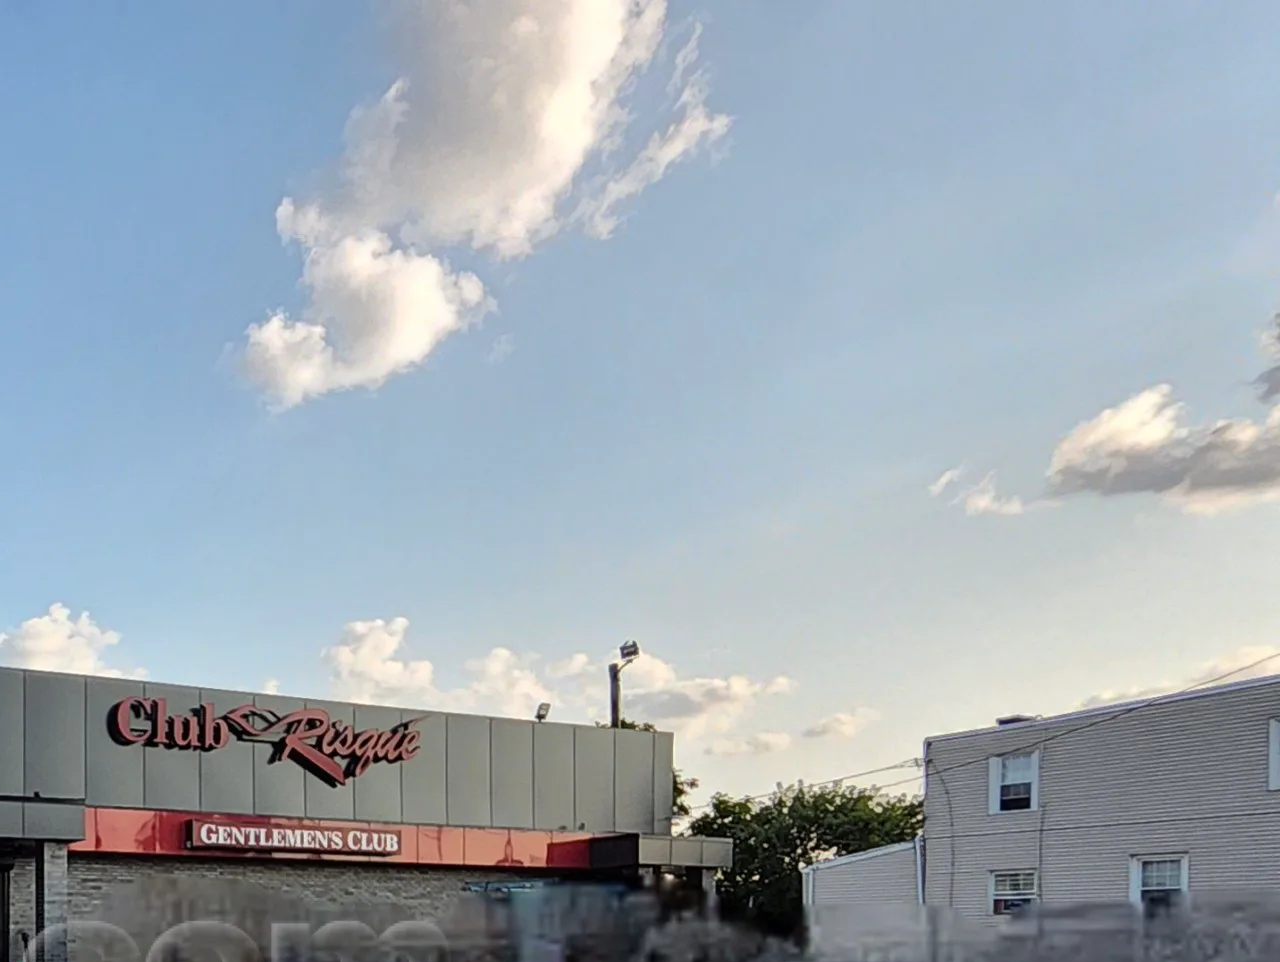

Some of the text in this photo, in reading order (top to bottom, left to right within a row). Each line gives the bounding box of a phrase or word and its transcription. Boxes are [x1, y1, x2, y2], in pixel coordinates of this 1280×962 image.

[112, 695, 230, 751] Club
[200, 823, 399, 851] GENTLEMEN'S CLUB
